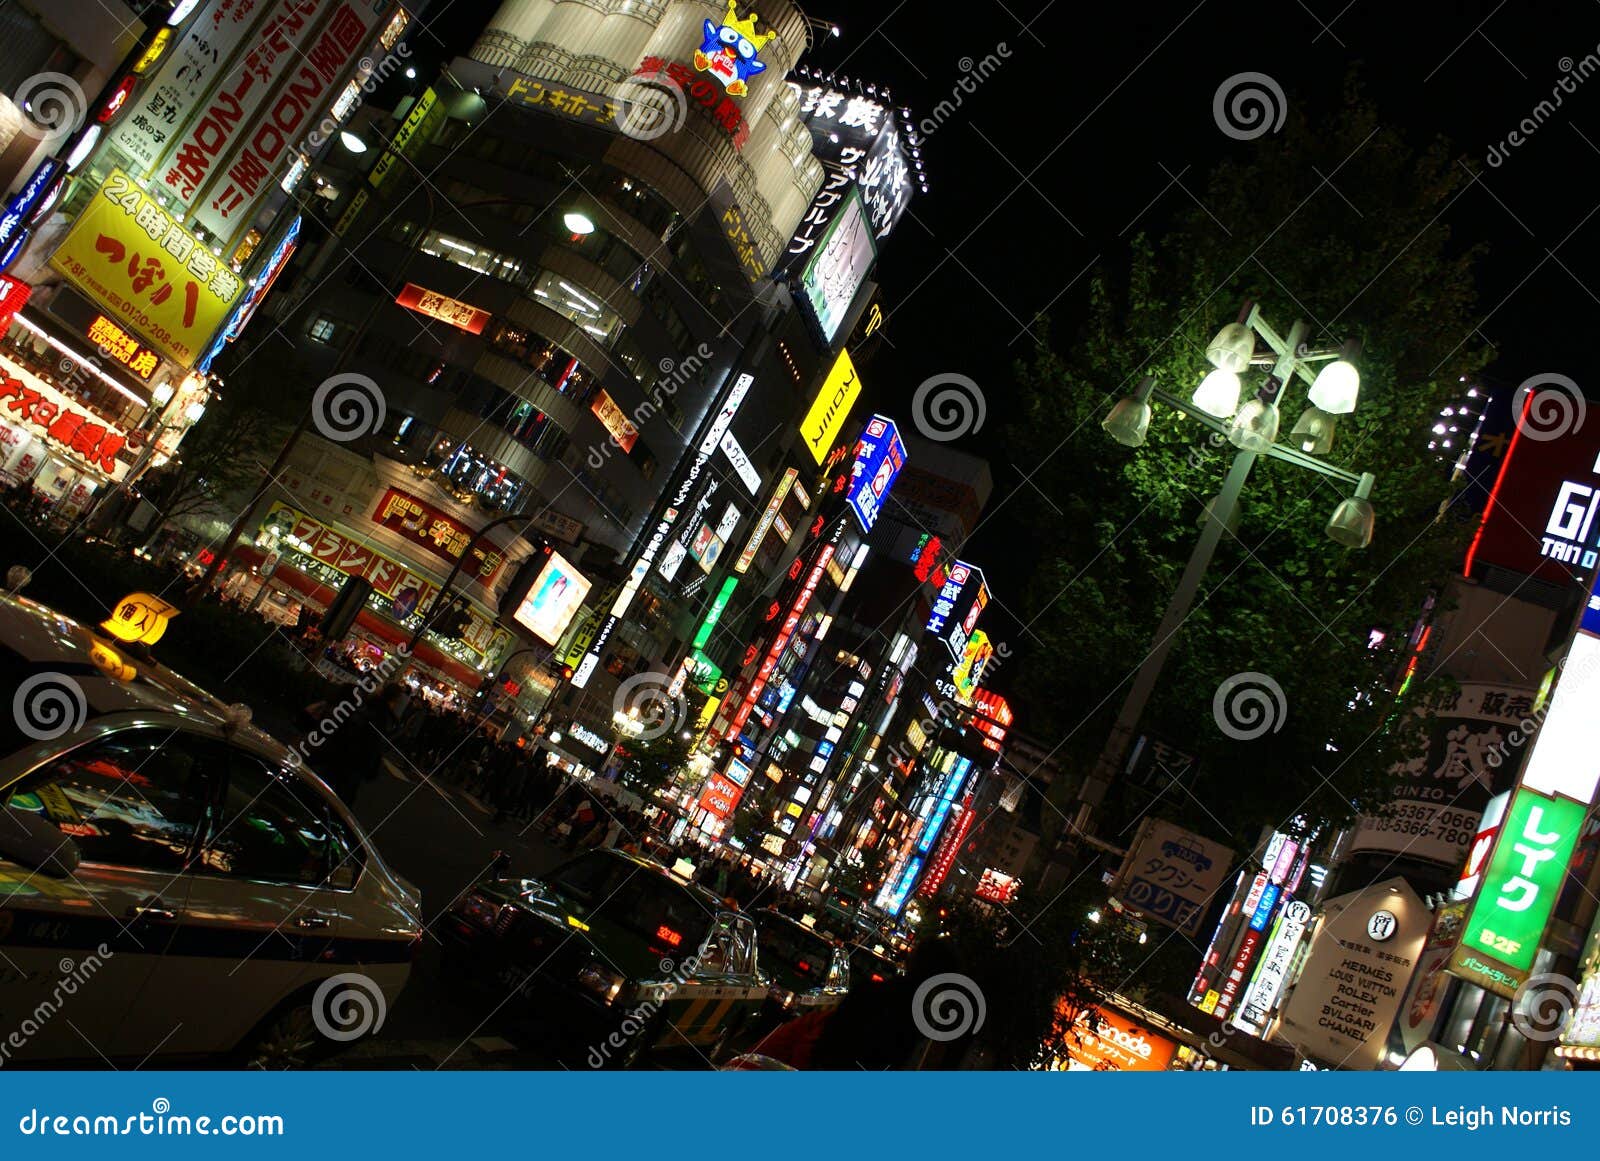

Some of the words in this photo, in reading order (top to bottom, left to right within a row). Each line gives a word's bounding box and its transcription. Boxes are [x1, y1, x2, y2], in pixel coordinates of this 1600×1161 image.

[103, 176, 241, 301] 24時間営業
[96, 234, 200, 328] つぼ八
[120, 302, 190, 357] 0120-208-413
[119, 603, 148, 633] 個人
[924, 580, 961, 634] 武富士
[1497, 805, 1560, 912] レイク
[1144, 858, 1209, 894] タクシー
[1127, 877, 1199, 937] のりば
[1479, 927, 1522, 957] B2F
[1328, 968, 1354, 982] LOUIS
[1356, 977, 1397, 997] VUITTON
[1336, 984, 1378, 1004] ROLEX
[1321, 1005, 1376, 1032] BVLGARI
[1329, 995, 1376, 1017] Cartier
[1318, 1016, 1368, 1043] CHANEL
